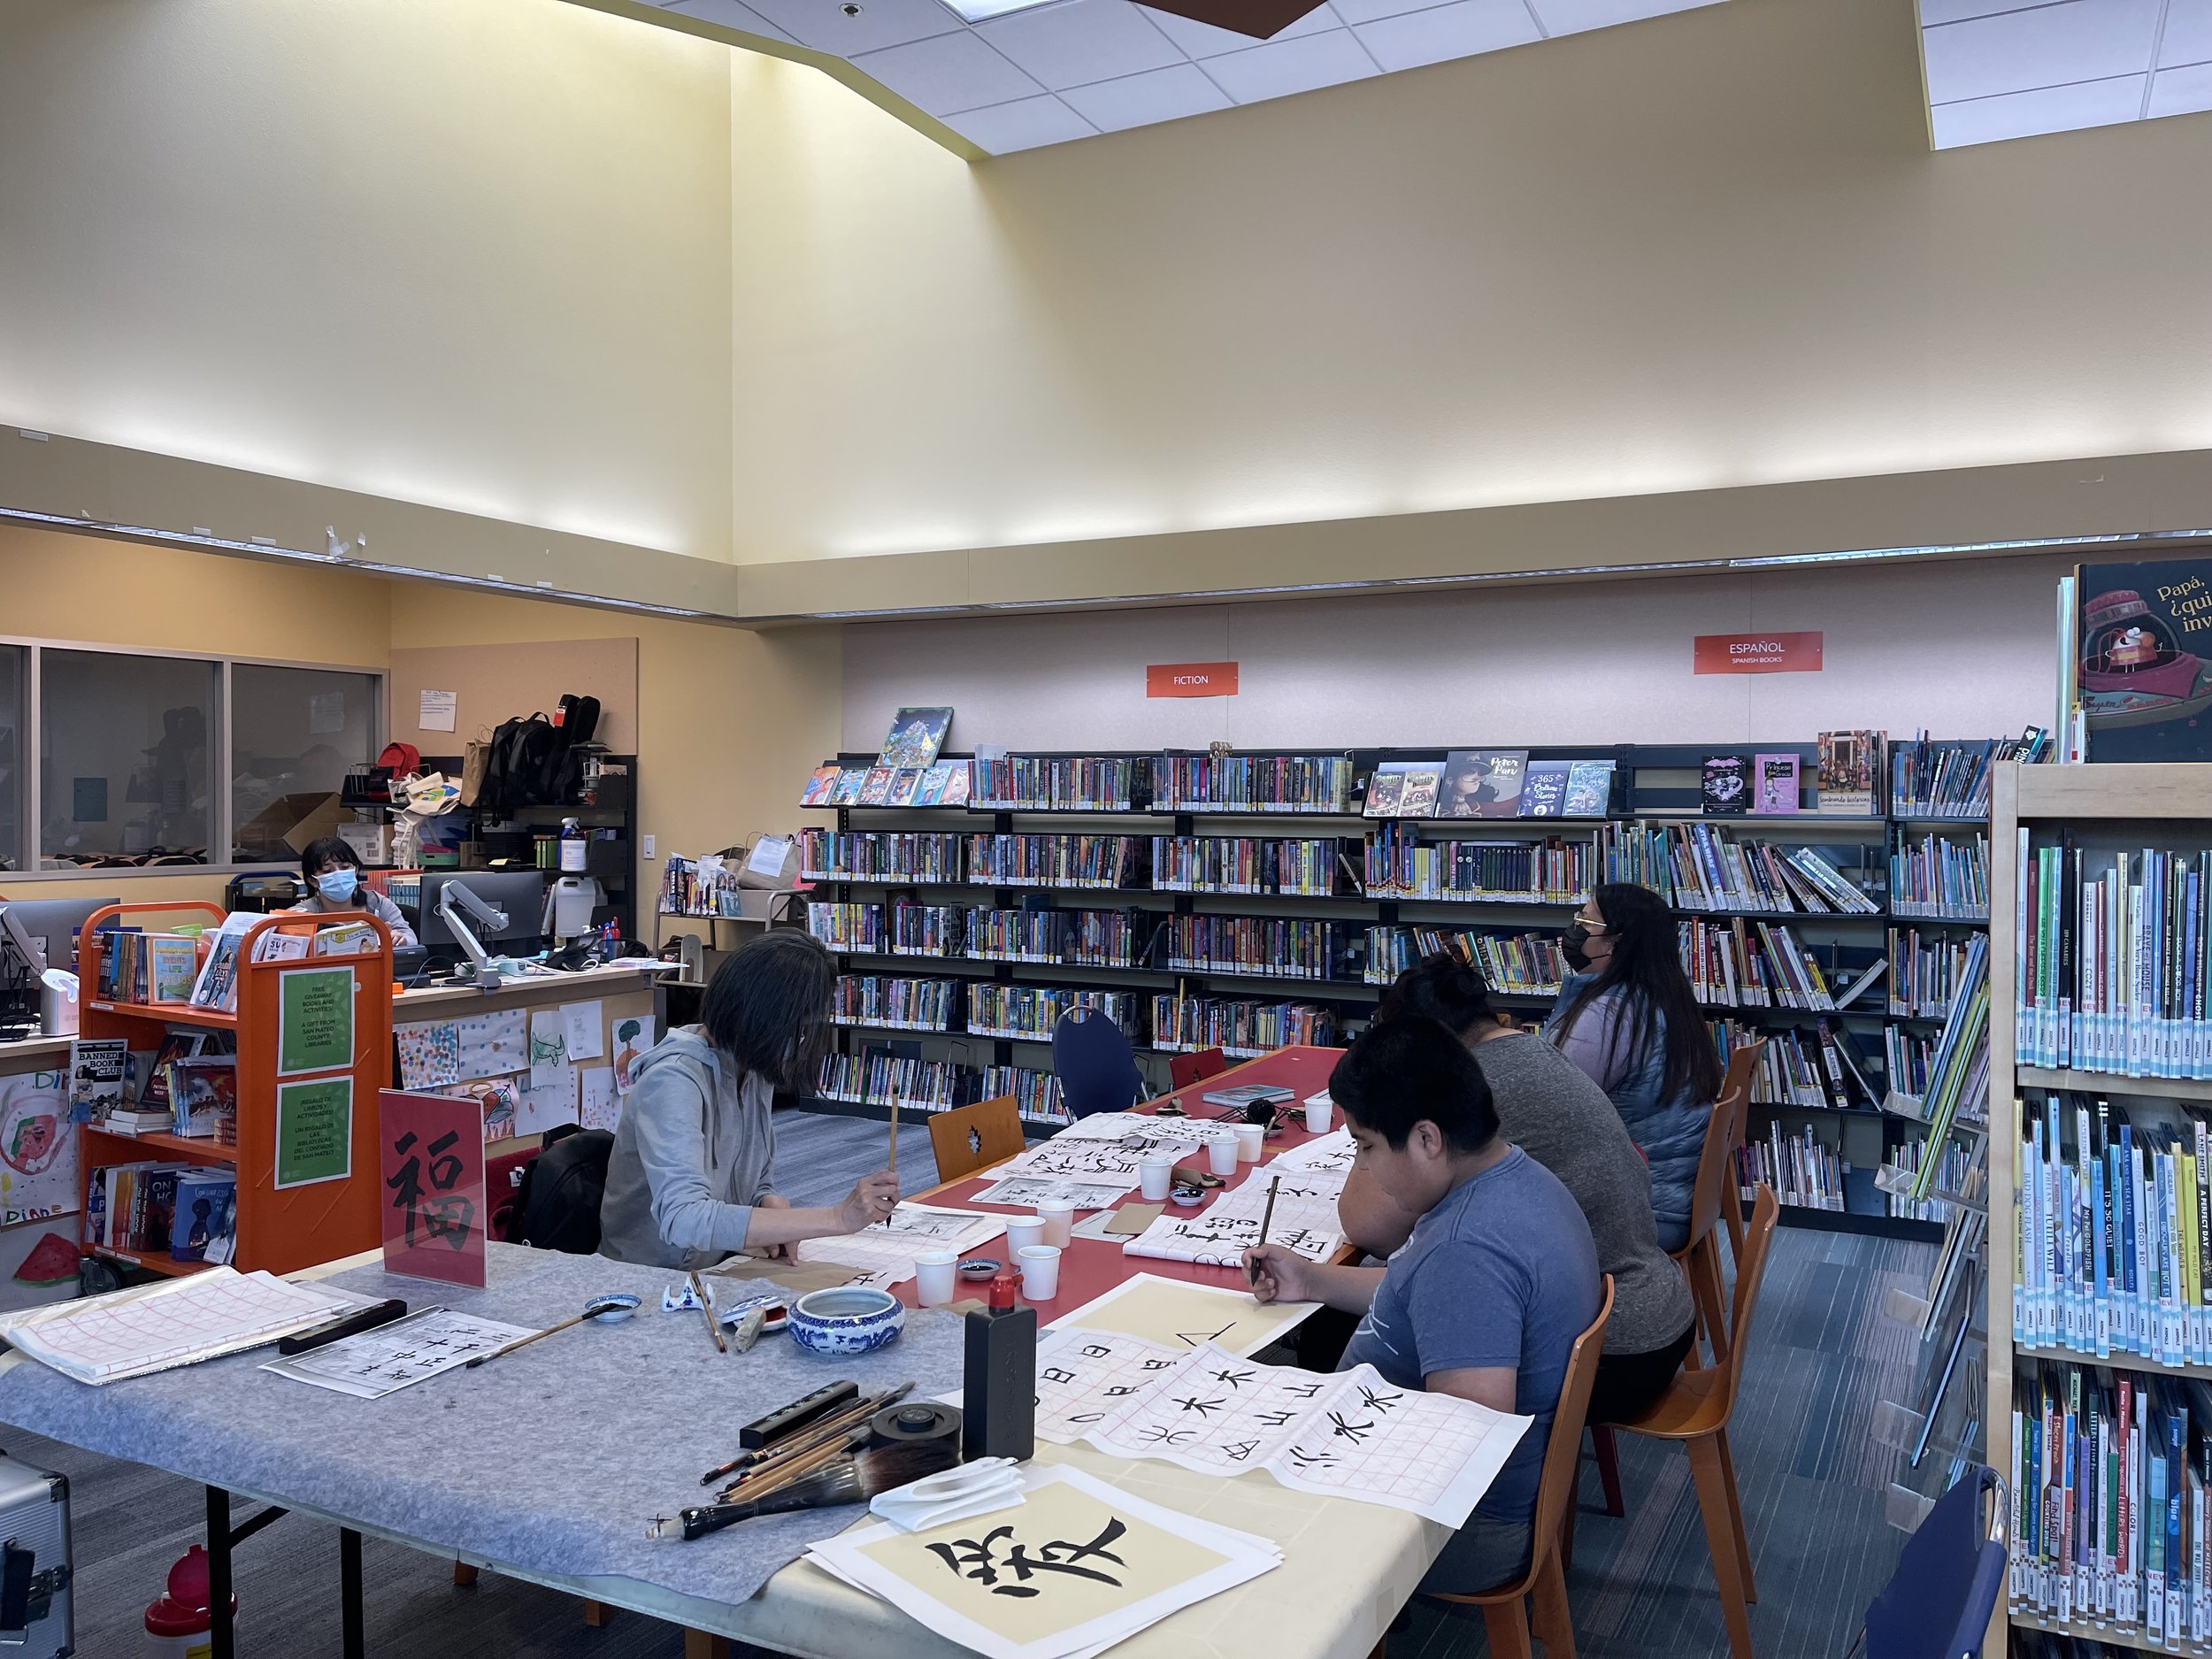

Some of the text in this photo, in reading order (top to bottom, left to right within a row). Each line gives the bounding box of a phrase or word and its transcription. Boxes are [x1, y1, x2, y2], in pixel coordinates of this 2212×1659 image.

[2156, 575, 2205, 602] Papá,
[1730, 641, 1785, 654] ESPAÑOL
[1173, 675, 1209, 685] FICTION
[1491, 757, 1518, 767] Peter
[1494, 764, 1517, 776] Pan
[1538, 774, 1554, 783] 365
[2141, 925, 2151, 950] BRAVE
[297, 1137, 332, 1147] BIBLIOTECAS
[152, 1181, 171, 1191] ON
[387, 1130, 475, 1251] 福
[2105, 1210, 2112, 1224] SO
[2105, 1226, 2114, 1248] QUIET
[386, 1351, 417, 1363] 中
[2050, 1502, 2059, 1519] Find
